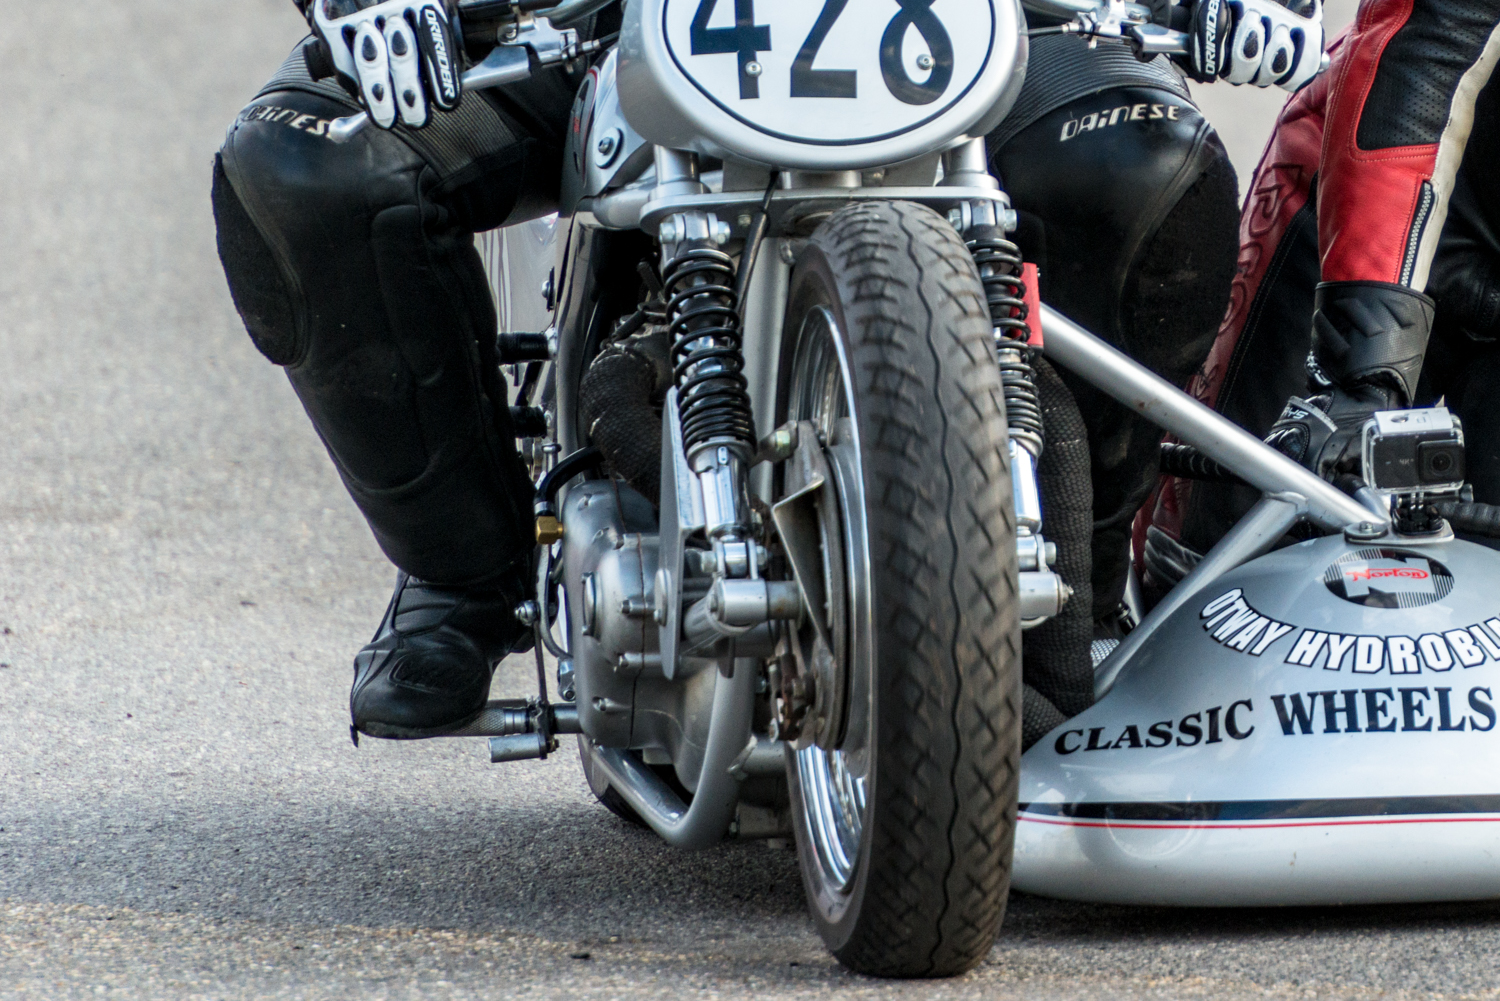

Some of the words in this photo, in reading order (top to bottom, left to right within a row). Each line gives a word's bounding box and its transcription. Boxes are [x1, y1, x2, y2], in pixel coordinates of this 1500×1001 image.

[1345, 567, 1429, 582] Norton
[1200, 588, 1298, 656] OTWAY
[1053, 698, 1255, 756] CLASSIC
[1270, 686, 1497, 736] WHEELS
